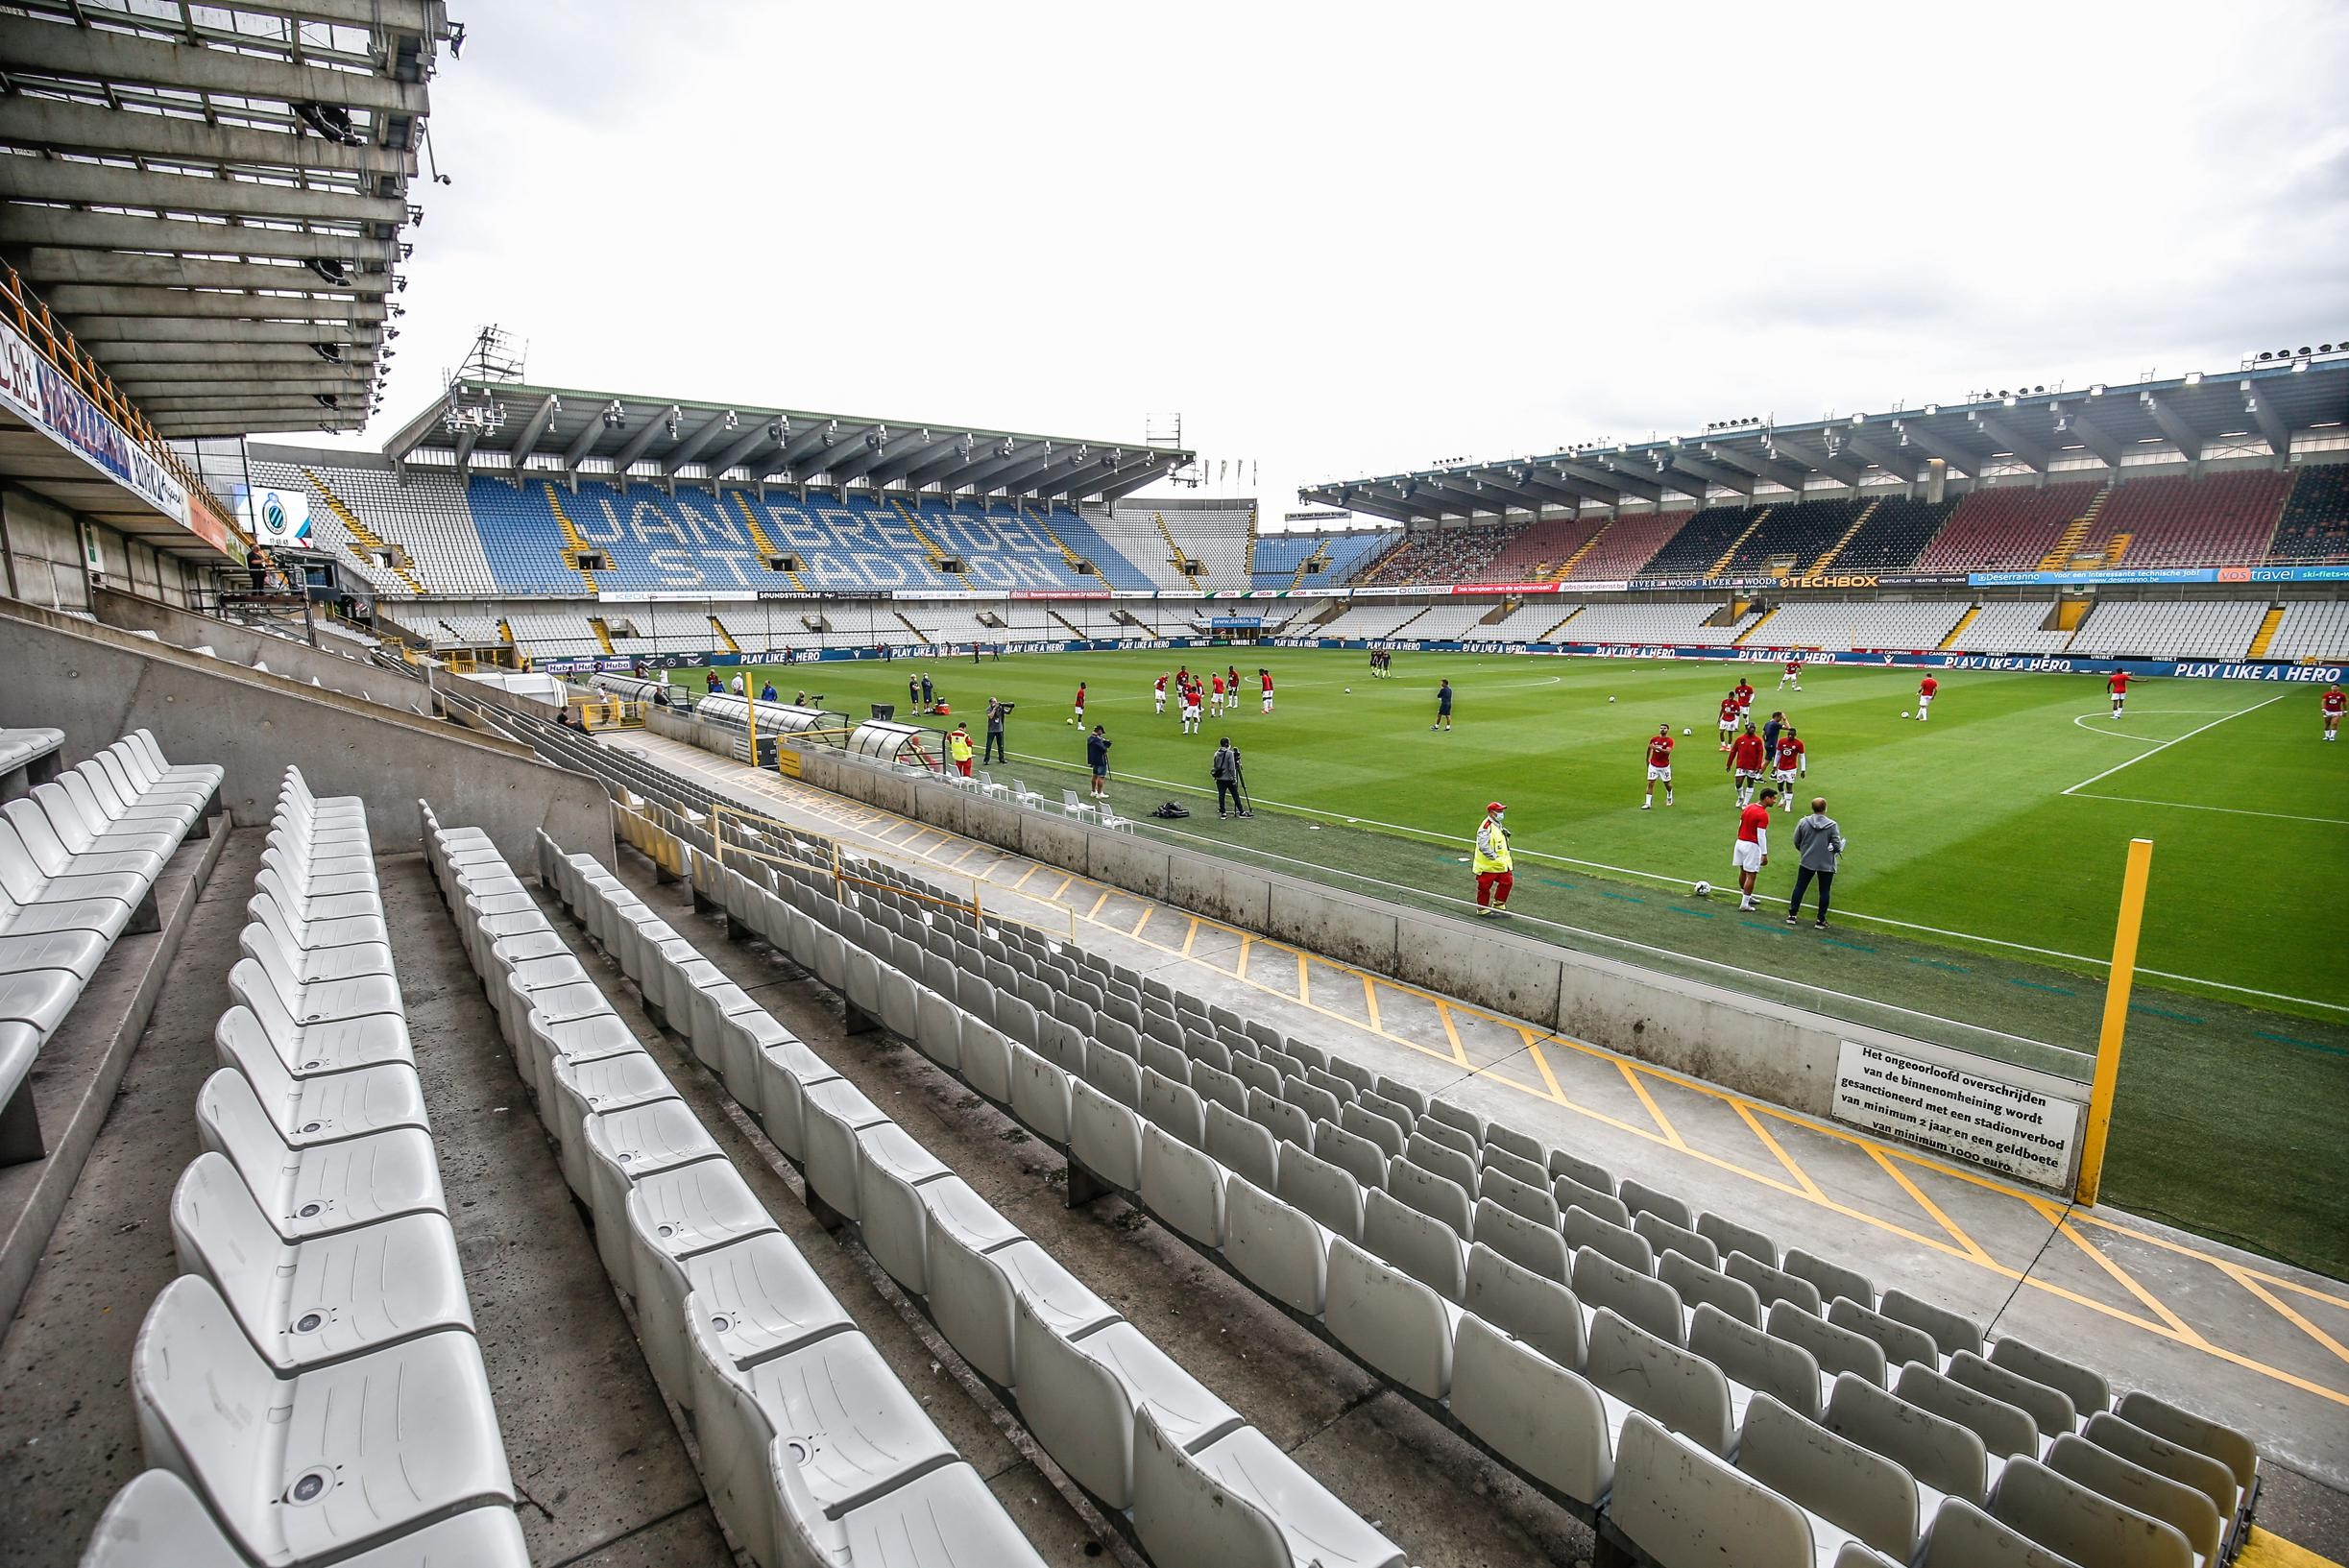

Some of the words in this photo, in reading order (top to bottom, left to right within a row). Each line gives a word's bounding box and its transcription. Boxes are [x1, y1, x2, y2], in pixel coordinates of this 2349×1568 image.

[573, 498, 745, 544] JAN
[765, 505, 1063, 552] BREYDEL
[2251, 569, 2294, 579] travel
[1790, 576, 1878, 587] TECHBOX
[1047, 643, 1064, 652] HERO
[1135, 640, 1147, 649] LIKE
[1153, 639, 1170, 648] HERO
[1304, 639, 1319, 648] HERO
[1367, 640, 1382, 649] PLAY
[1383, 641, 1396, 650] LIKE
[1403, 641, 1420, 650] HERO
[740, 655, 763, 664] PLAY
[765, 653, 786, 663] LIKE
[796, 652, 820, 662] HERO
[892, 647, 911, 658] PLAY
[914, 646, 931, 657] LIKE
[2174, 663, 2217, 678] PLAY
[2222, 665, 2263, 679] LIKE
[2264, 666, 2278, 680] A
[2285, 666, 2340, 682] HERO
[1863, 1047, 1882, 1061] Het
[1885, 1054, 1960, 1083] ongeoorloofd
[1962, 1074, 2046, 1107] overschrijden
[1863, 1065, 1883, 1078] van
[1886, 1069, 1900, 1082] de
[1901, 1073, 2003, 1116] binnenomheining
[2005, 1105, 2044, 1125] wordt
[1841, 1075, 1924, 1108] gesanctioneerd
[1925, 1100, 1949, 1115] met
[1950, 1109, 1972, 1123] een
[1974, 1114, 2065, 1150] stadionverbod
[1841, 1095, 1860, 1106] van
[1864, 1099, 1917, 1122] minimum
[1927, 1118, 1952, 1135] jaar
[1954, 1128, 1968, 1139] en
[1971, 1134, 1993, 1147] een
[1996, 1141, 2059, 1169] geldboete
[1872, 1121, 1892, 1133] van
[1895, 1126, 1948, 1152] minimum
[1949, 1145, 1980, 1162] 1000
[1982, 1156, 2014, 1173] euro.
